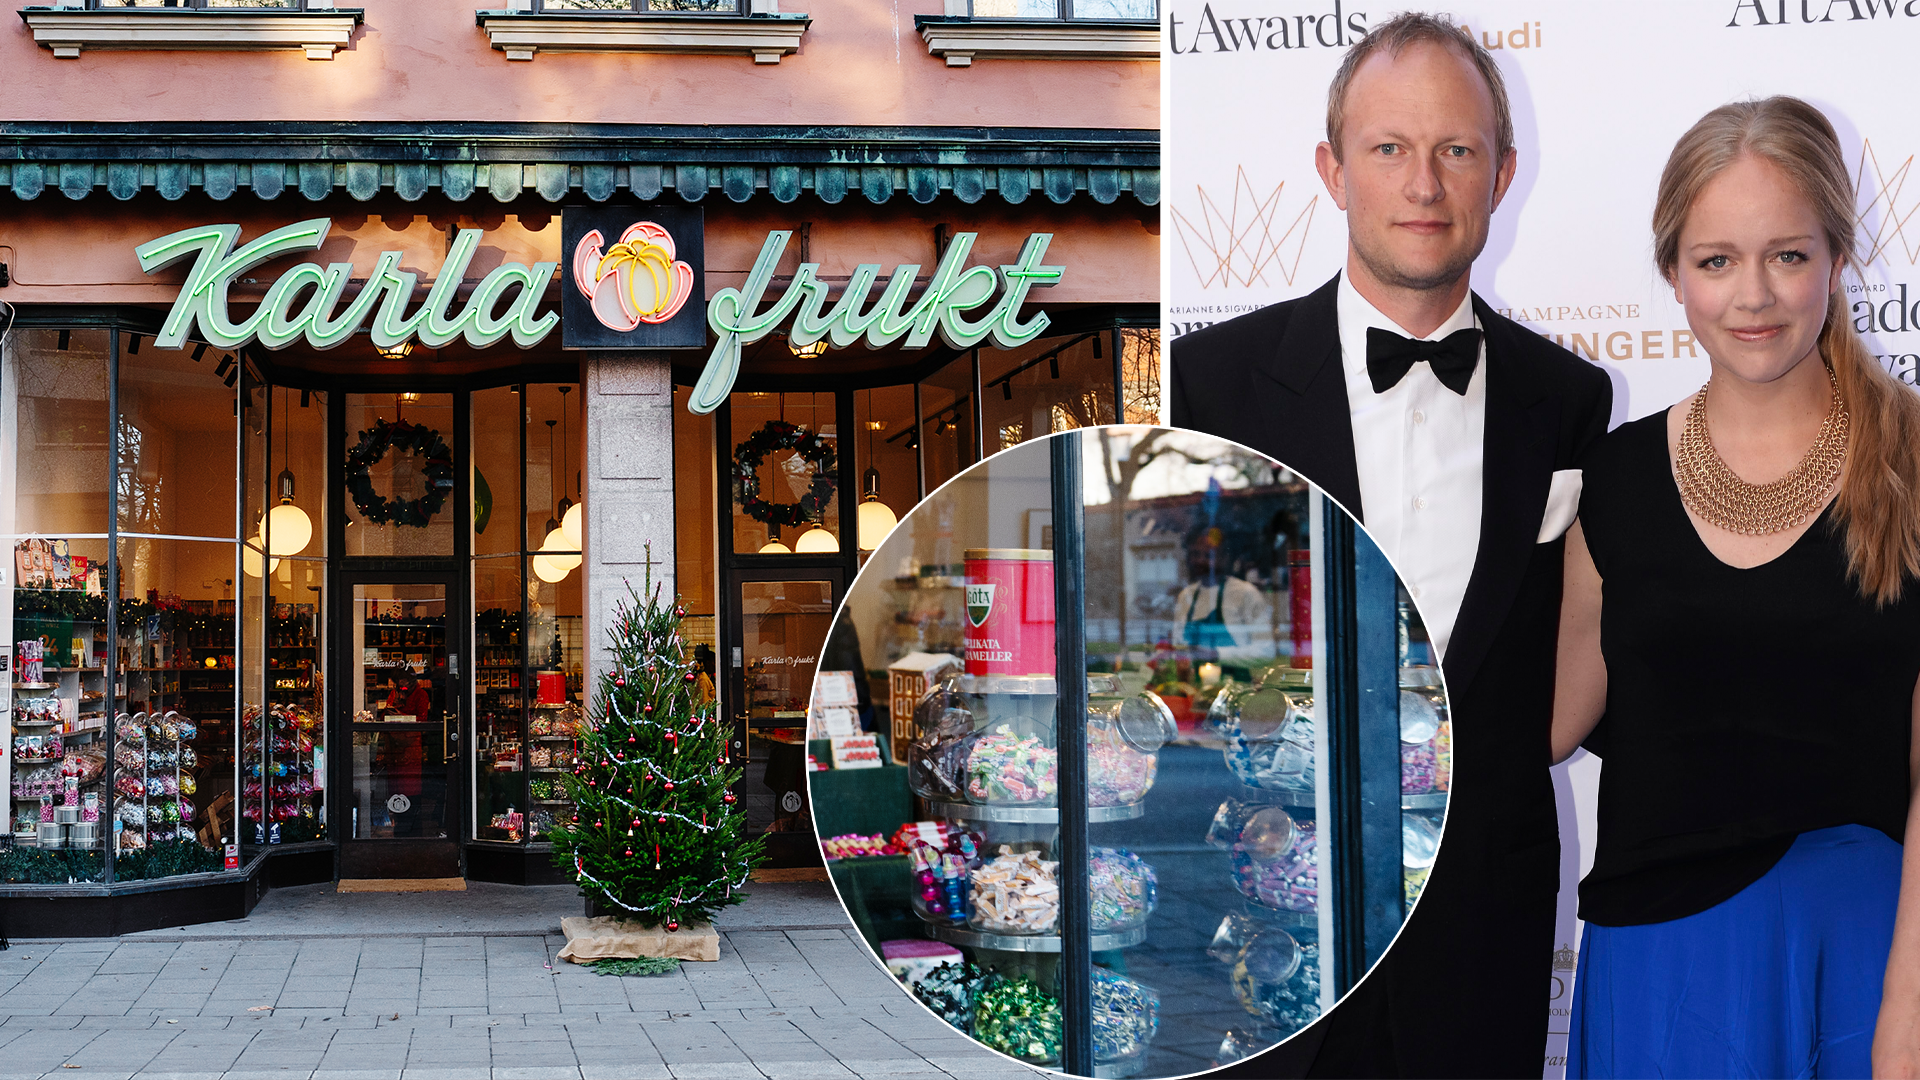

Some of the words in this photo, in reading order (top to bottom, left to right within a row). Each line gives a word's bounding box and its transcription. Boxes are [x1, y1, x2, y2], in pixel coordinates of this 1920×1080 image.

[1216, 305, 1222, 314] &
[135, 217, 560, 351] Karla
[687, 229, 1067, 415] frukt
[373, 659, 397, 668] Karla
[404, 658, 428, 671] frukt
[761, 655, 785, 665] Karla
[793, 655, 815, 667] frukt
